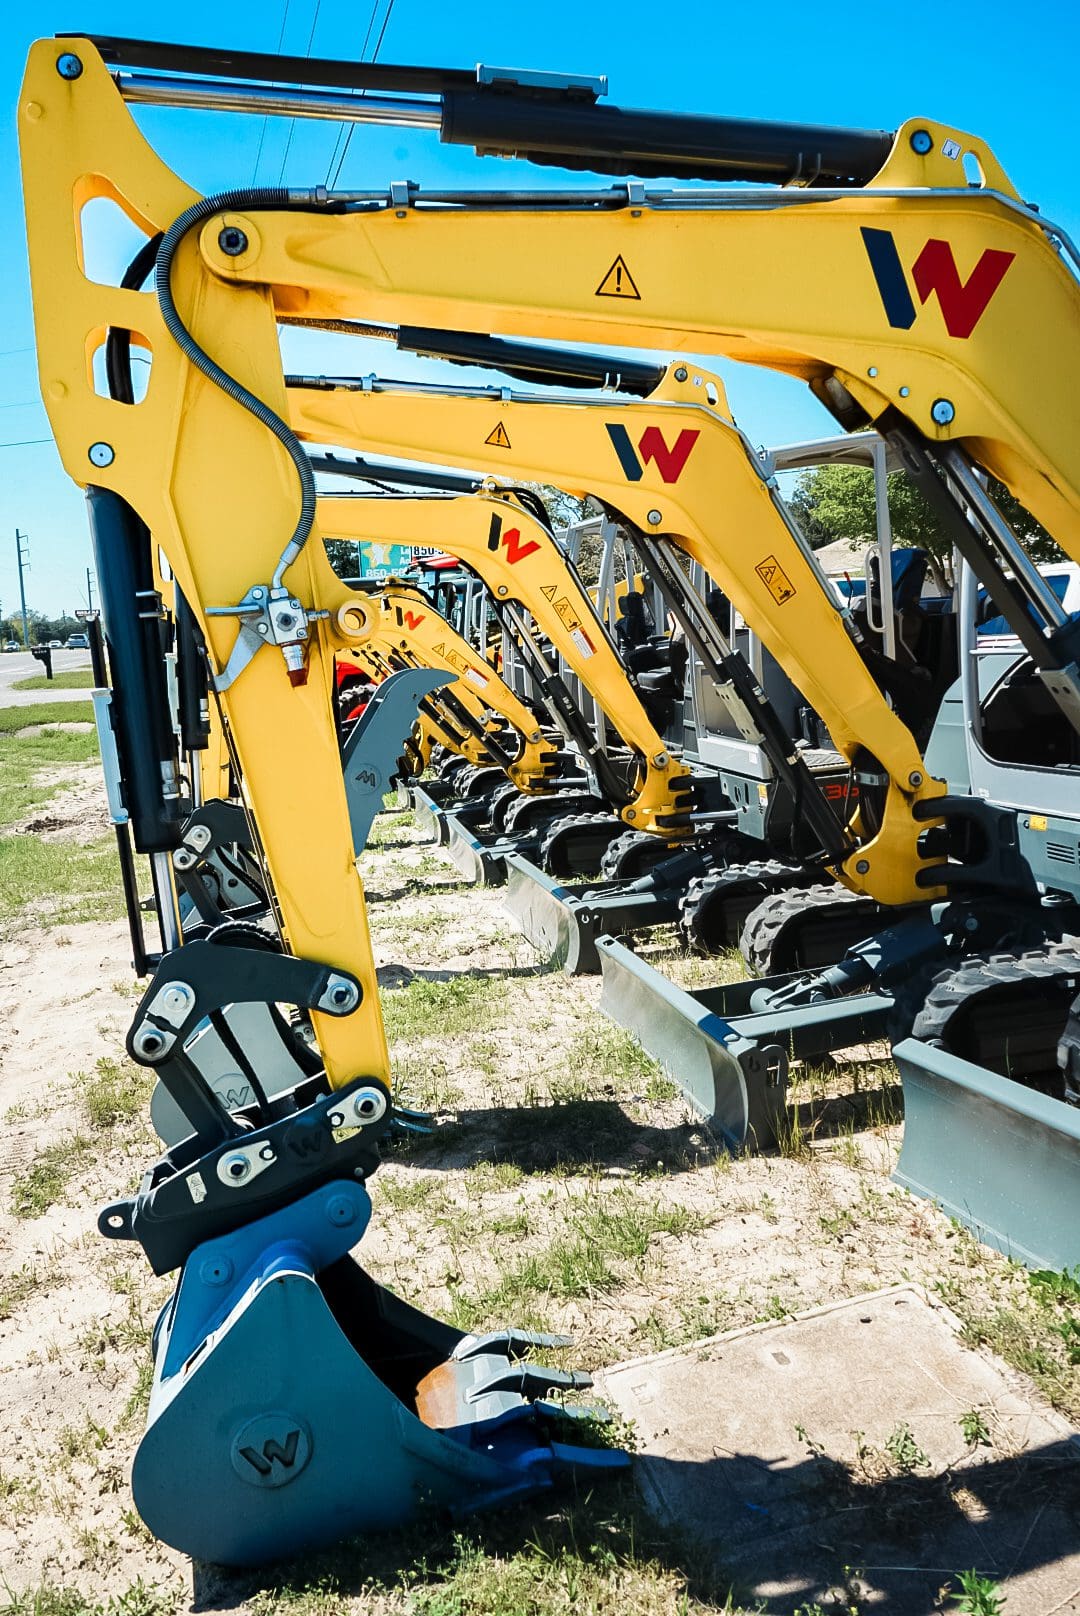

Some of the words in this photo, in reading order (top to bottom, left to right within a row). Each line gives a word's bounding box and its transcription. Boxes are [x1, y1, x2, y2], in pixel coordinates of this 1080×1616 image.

[860, 226, 1016, 339] W
[604, 422, 701, 484] W
[487, 511, 542, 565] W
[395, 605, 426, 631] W
[238, 1428, 301, 1475] W
